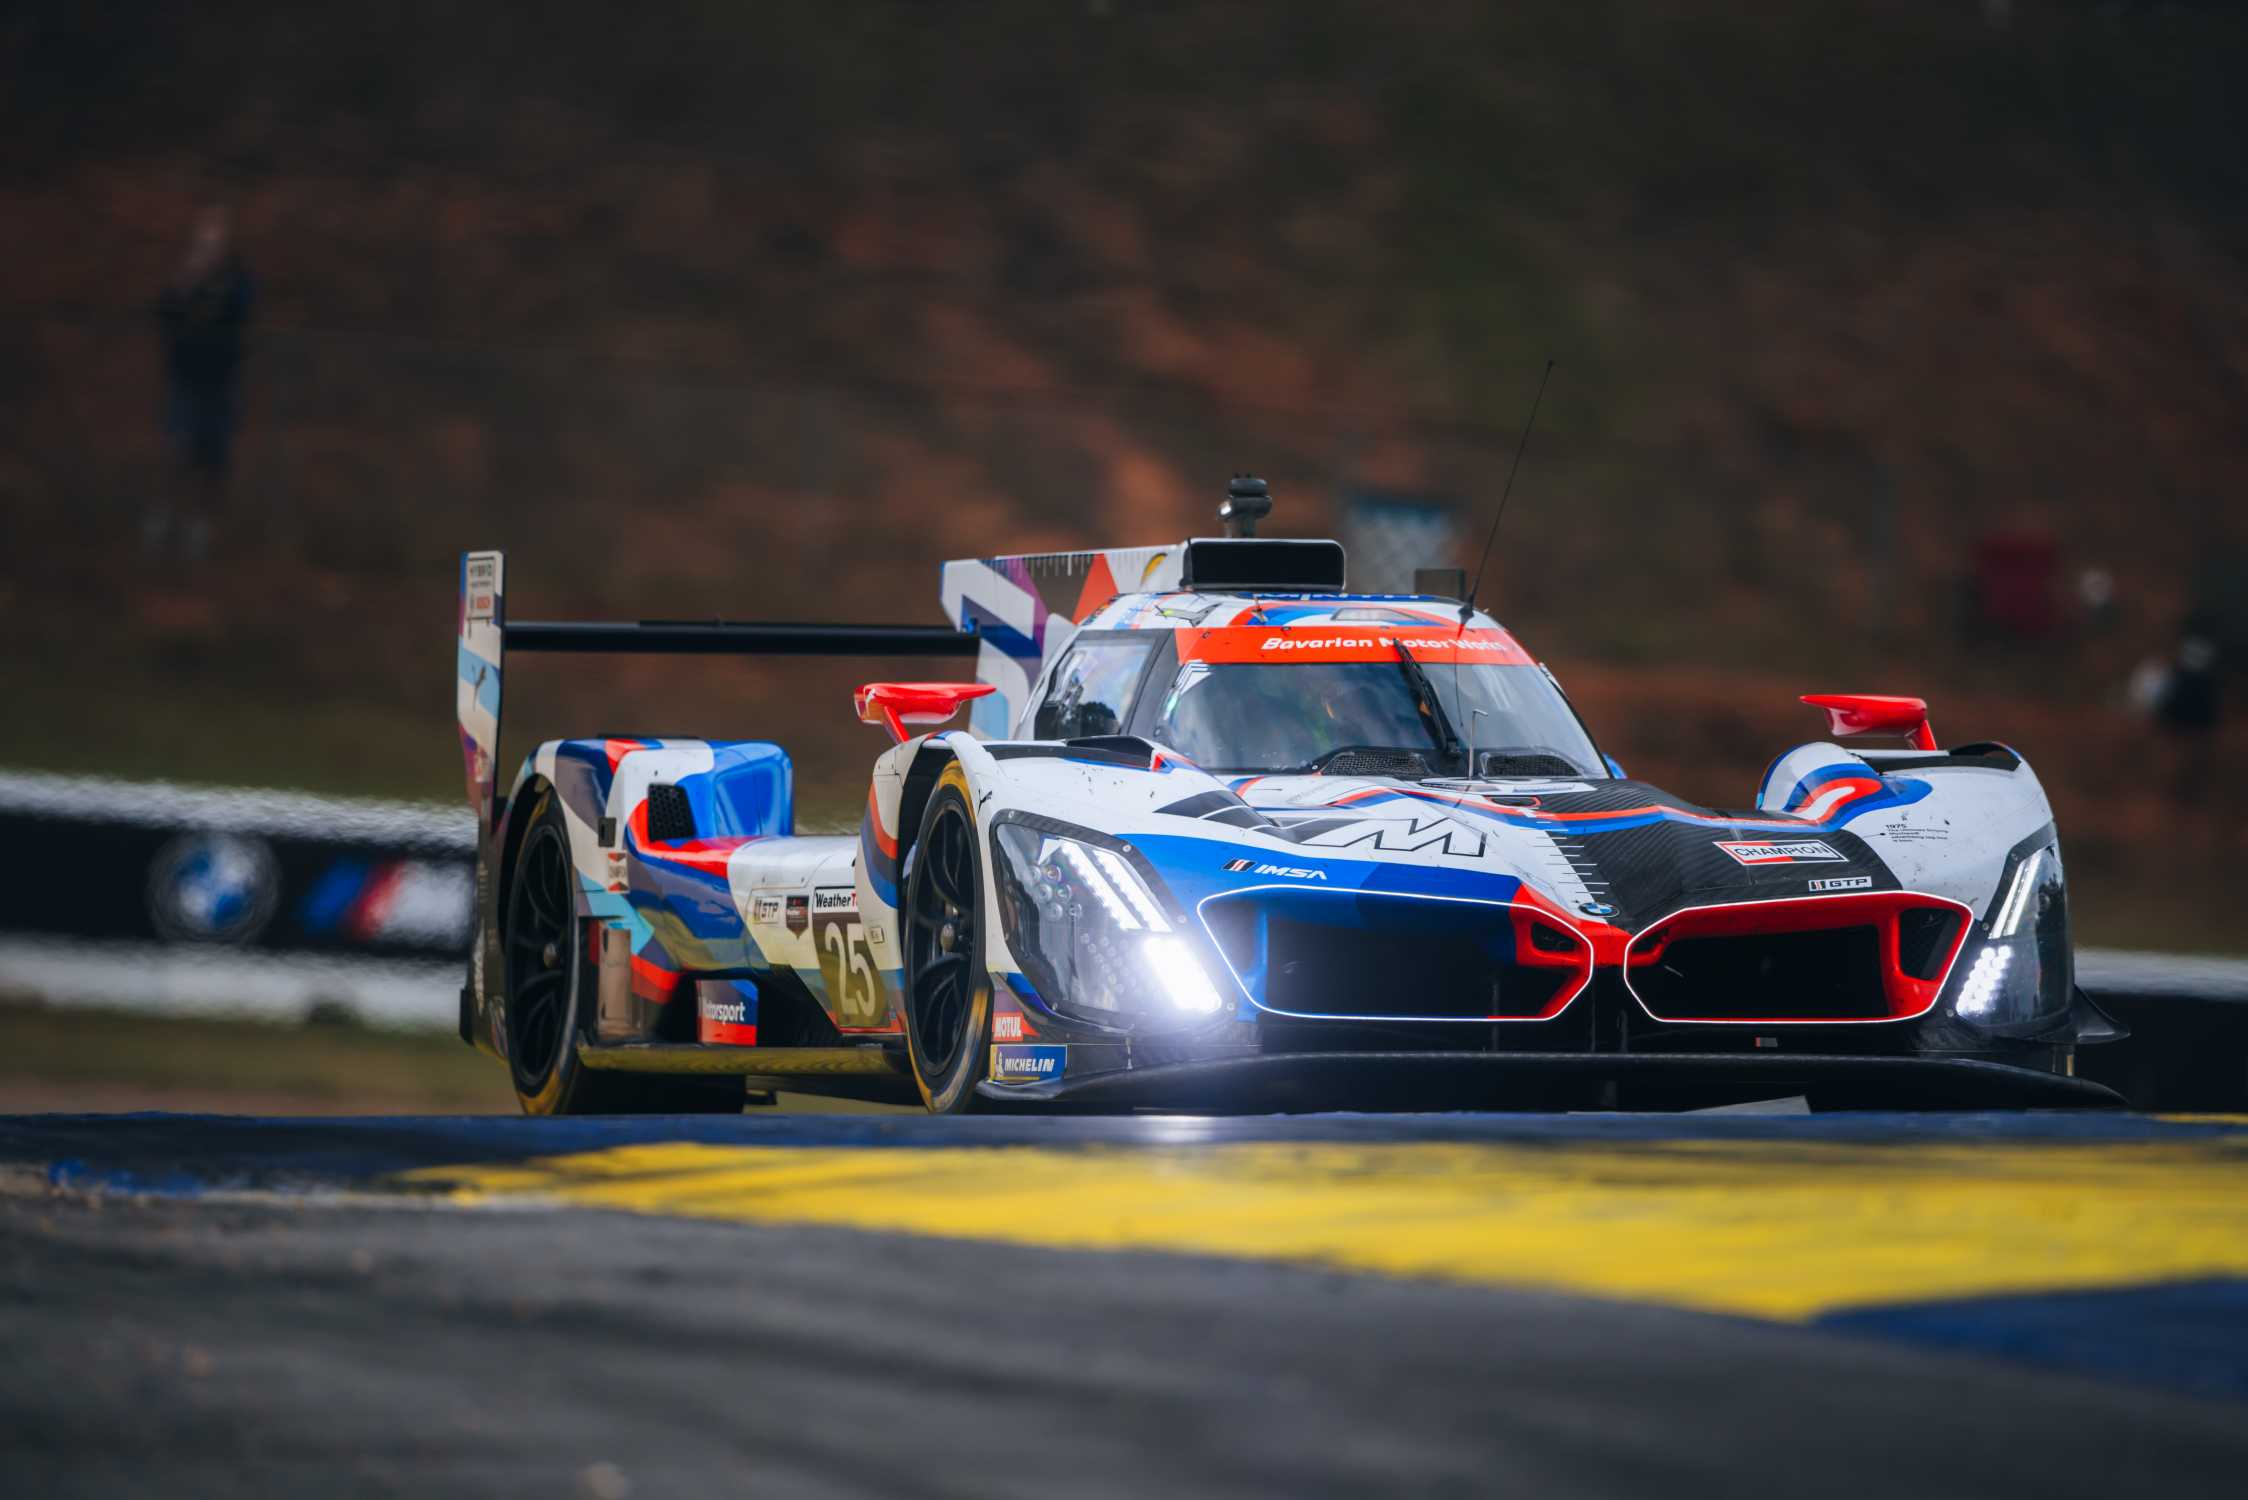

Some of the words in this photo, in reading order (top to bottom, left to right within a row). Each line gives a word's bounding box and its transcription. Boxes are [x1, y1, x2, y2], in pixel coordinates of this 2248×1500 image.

[1260, 637, 1374, 650] Bavarian
[1378, 636, 1450, 649] Motor
[1733, 844, 1832, 858] CHAMPION
[1253, 864, 1328, 880] IMSA
[1829, 877, 1868, 888] GTP
[815, 891, 858, 908] WeatherT
[760, 901, 780, 919] STP
[824, 921, 877, 1017] 25
[703, 999, 747, 1026] otorsport
[994, 1015, 1022, 1038] MOTUL
[1003, 1057, 1056, 1073] MICHELIN
